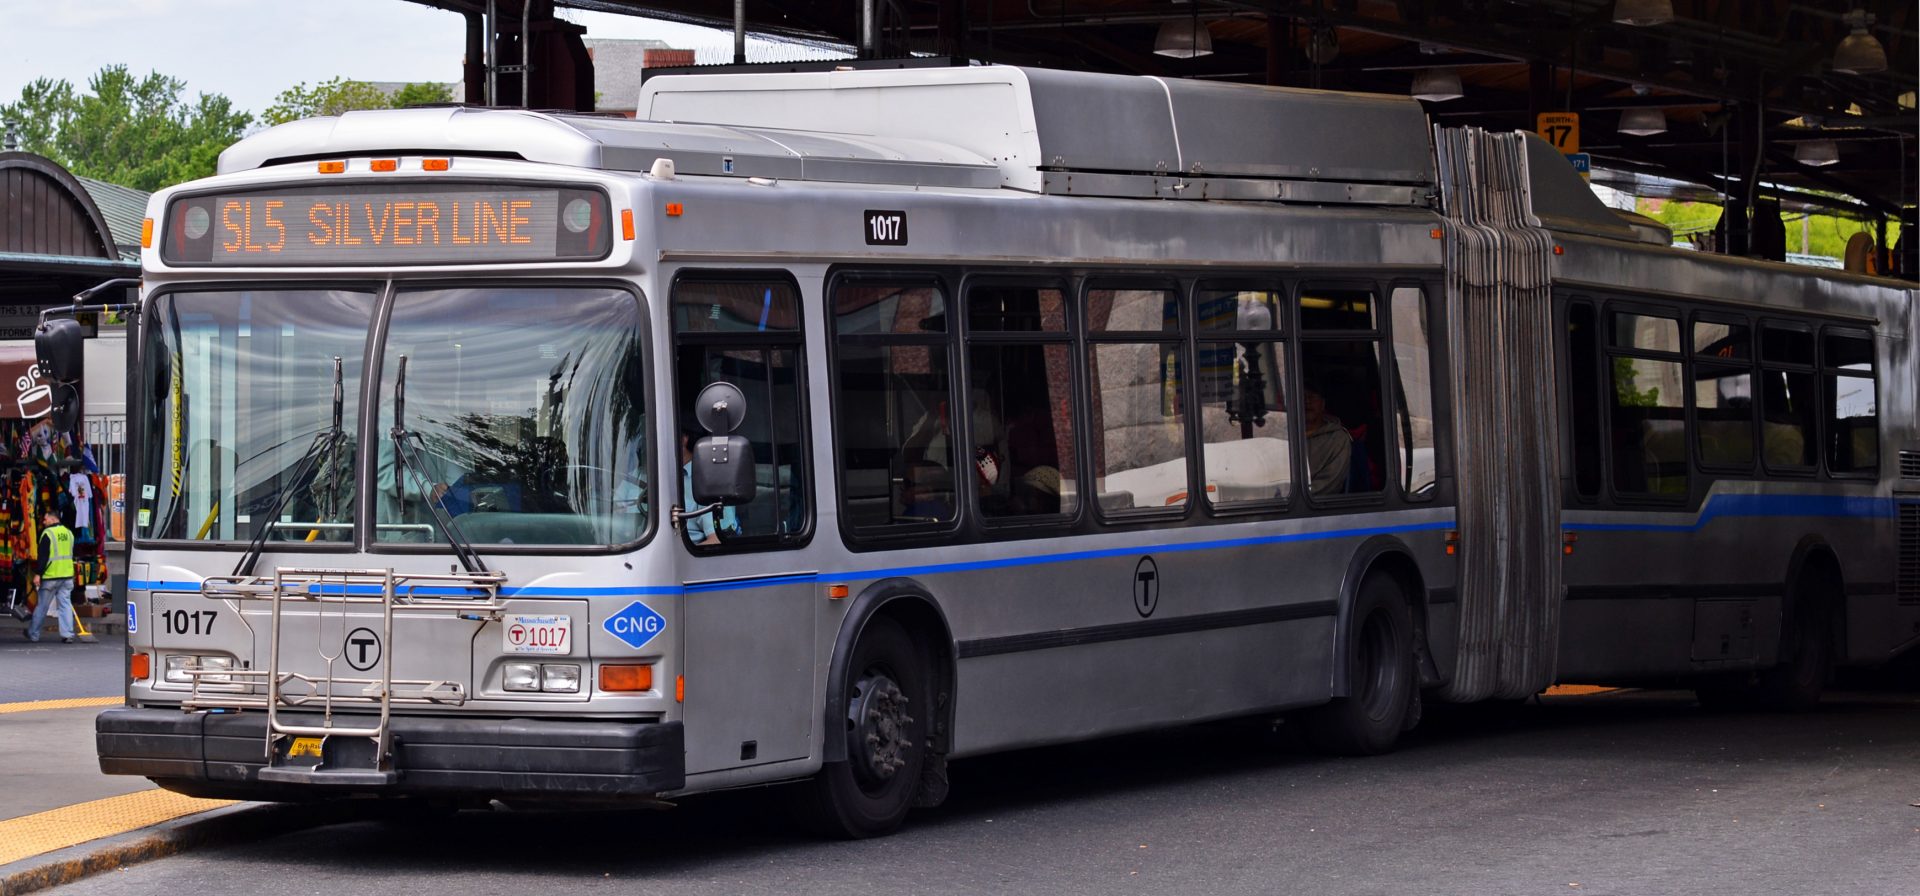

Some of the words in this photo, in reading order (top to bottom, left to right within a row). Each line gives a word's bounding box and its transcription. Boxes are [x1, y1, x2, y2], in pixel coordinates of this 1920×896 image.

[1544, 126, 1572, 147] 17
[223, 201, 286, 252] SL5
[308, 202, 439, 245] SILVER
[453, 200, 532, 244] LINE
[870, 215, 901, 240] 1017
[162, 609, 218, 635] 1017
[614, 616, 657, 633] CNG
[529, 627, 566, 647] 1017
